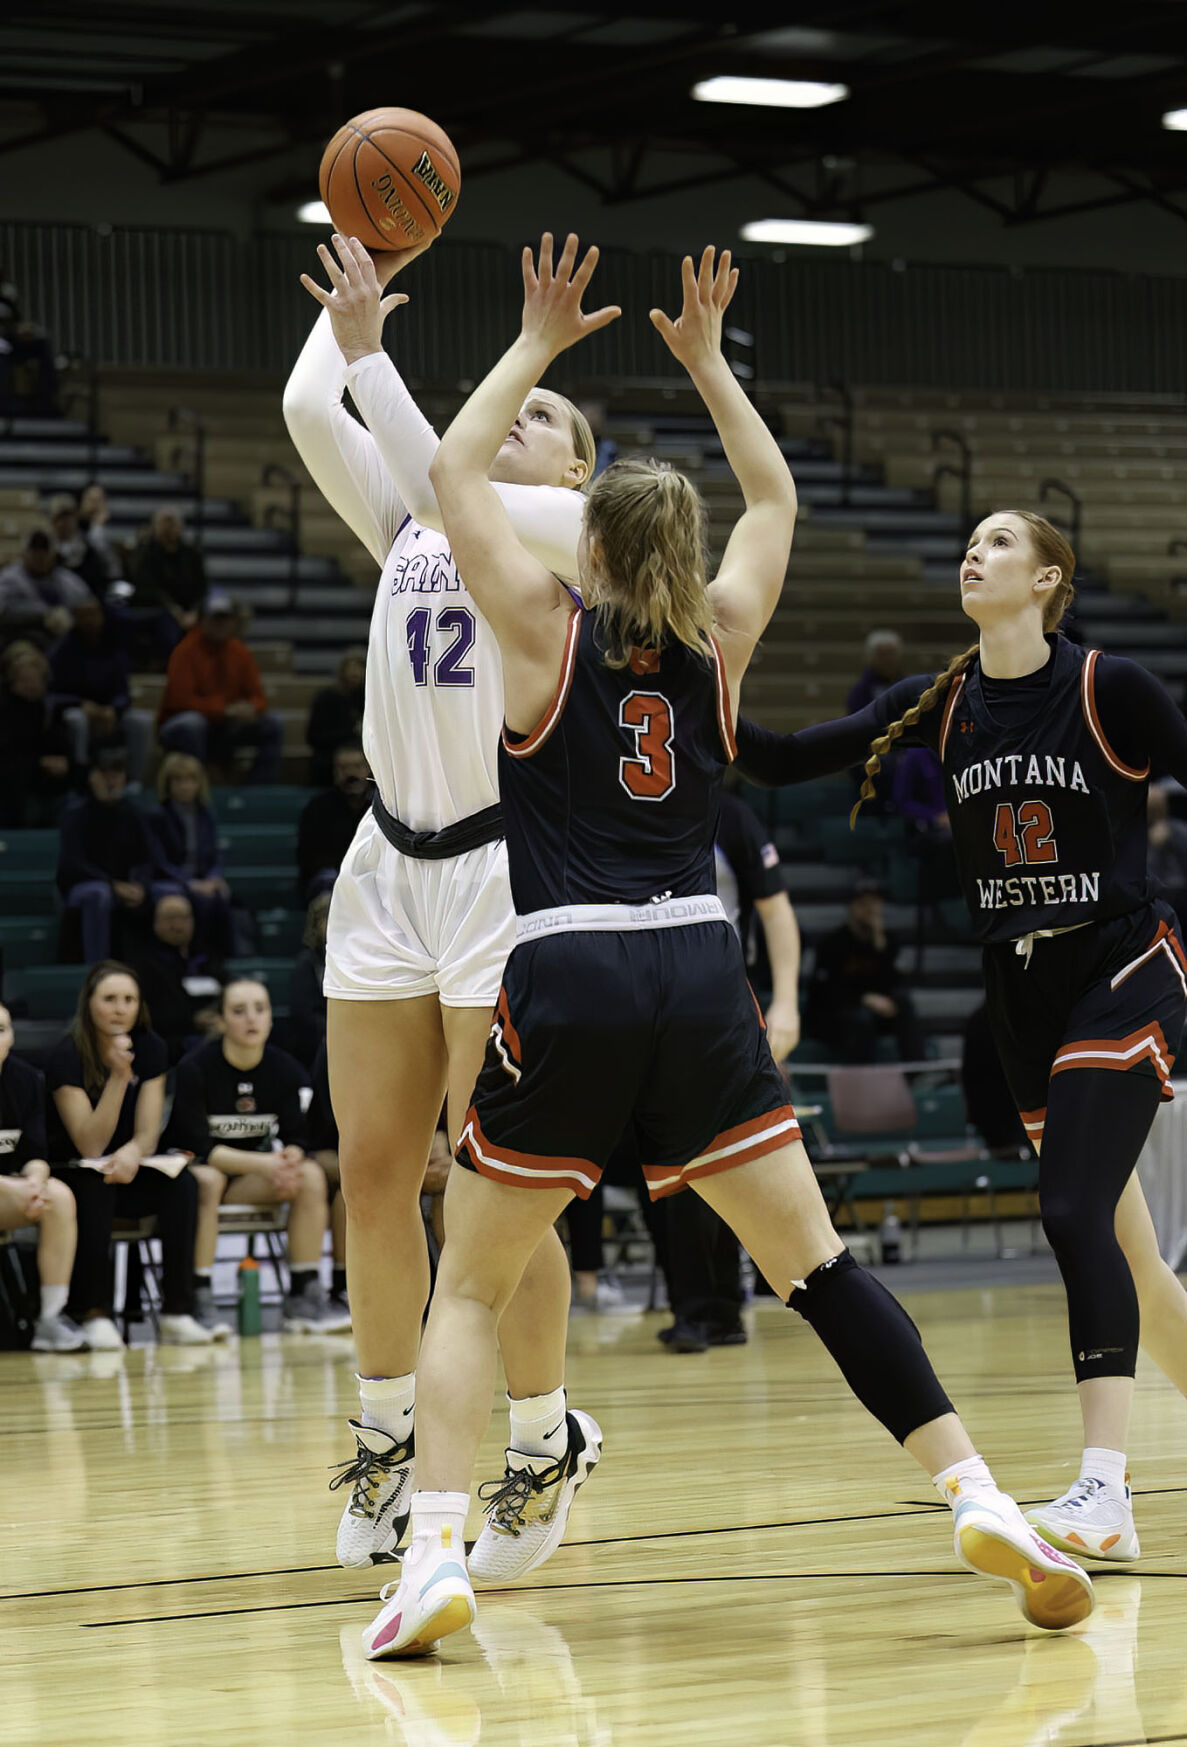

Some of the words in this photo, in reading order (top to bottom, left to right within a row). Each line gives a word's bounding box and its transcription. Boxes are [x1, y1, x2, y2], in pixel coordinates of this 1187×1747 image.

[406, 607, 476, 687] 42
[619, 690, 676, 802] 3
[952, 754, 1090, 804] MONTANA
[993, 800, 1059, 867] 42
[976, 872, 1100, 909] WESTERN
